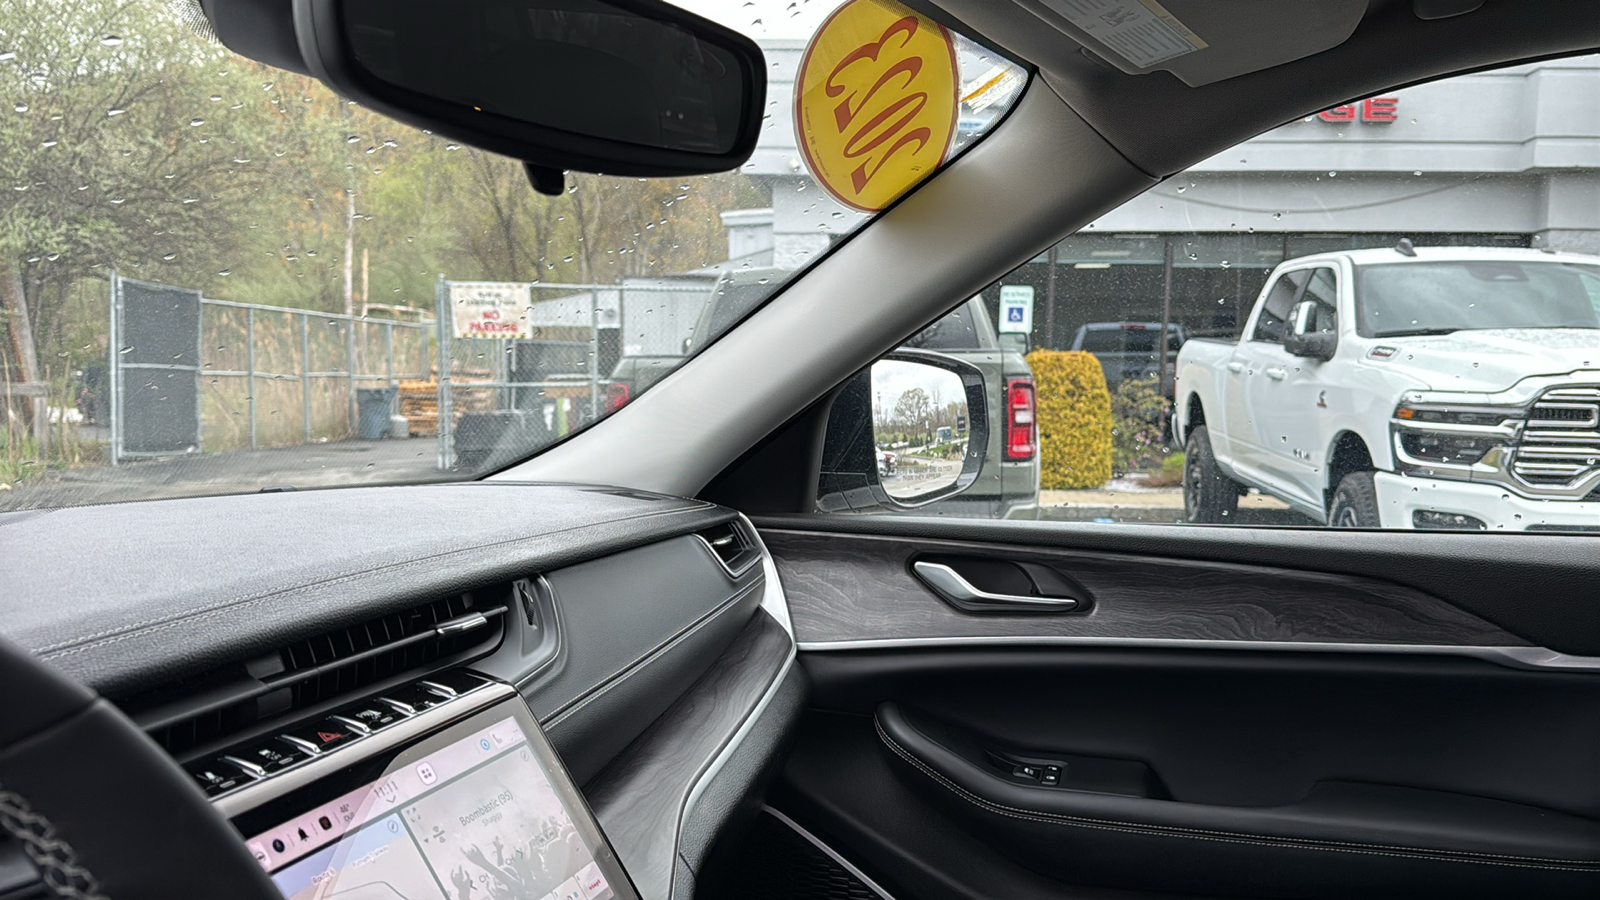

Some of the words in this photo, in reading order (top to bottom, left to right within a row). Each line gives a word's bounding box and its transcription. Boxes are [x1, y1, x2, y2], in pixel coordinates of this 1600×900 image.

[1296, 98, 1399, 122] GE
[482, 310, 500, 320] NO
[374, 780, 398, 798] 11:11
[458, 796, 500, 827] Boombastic
[498, 789, 514, 806] (95)
